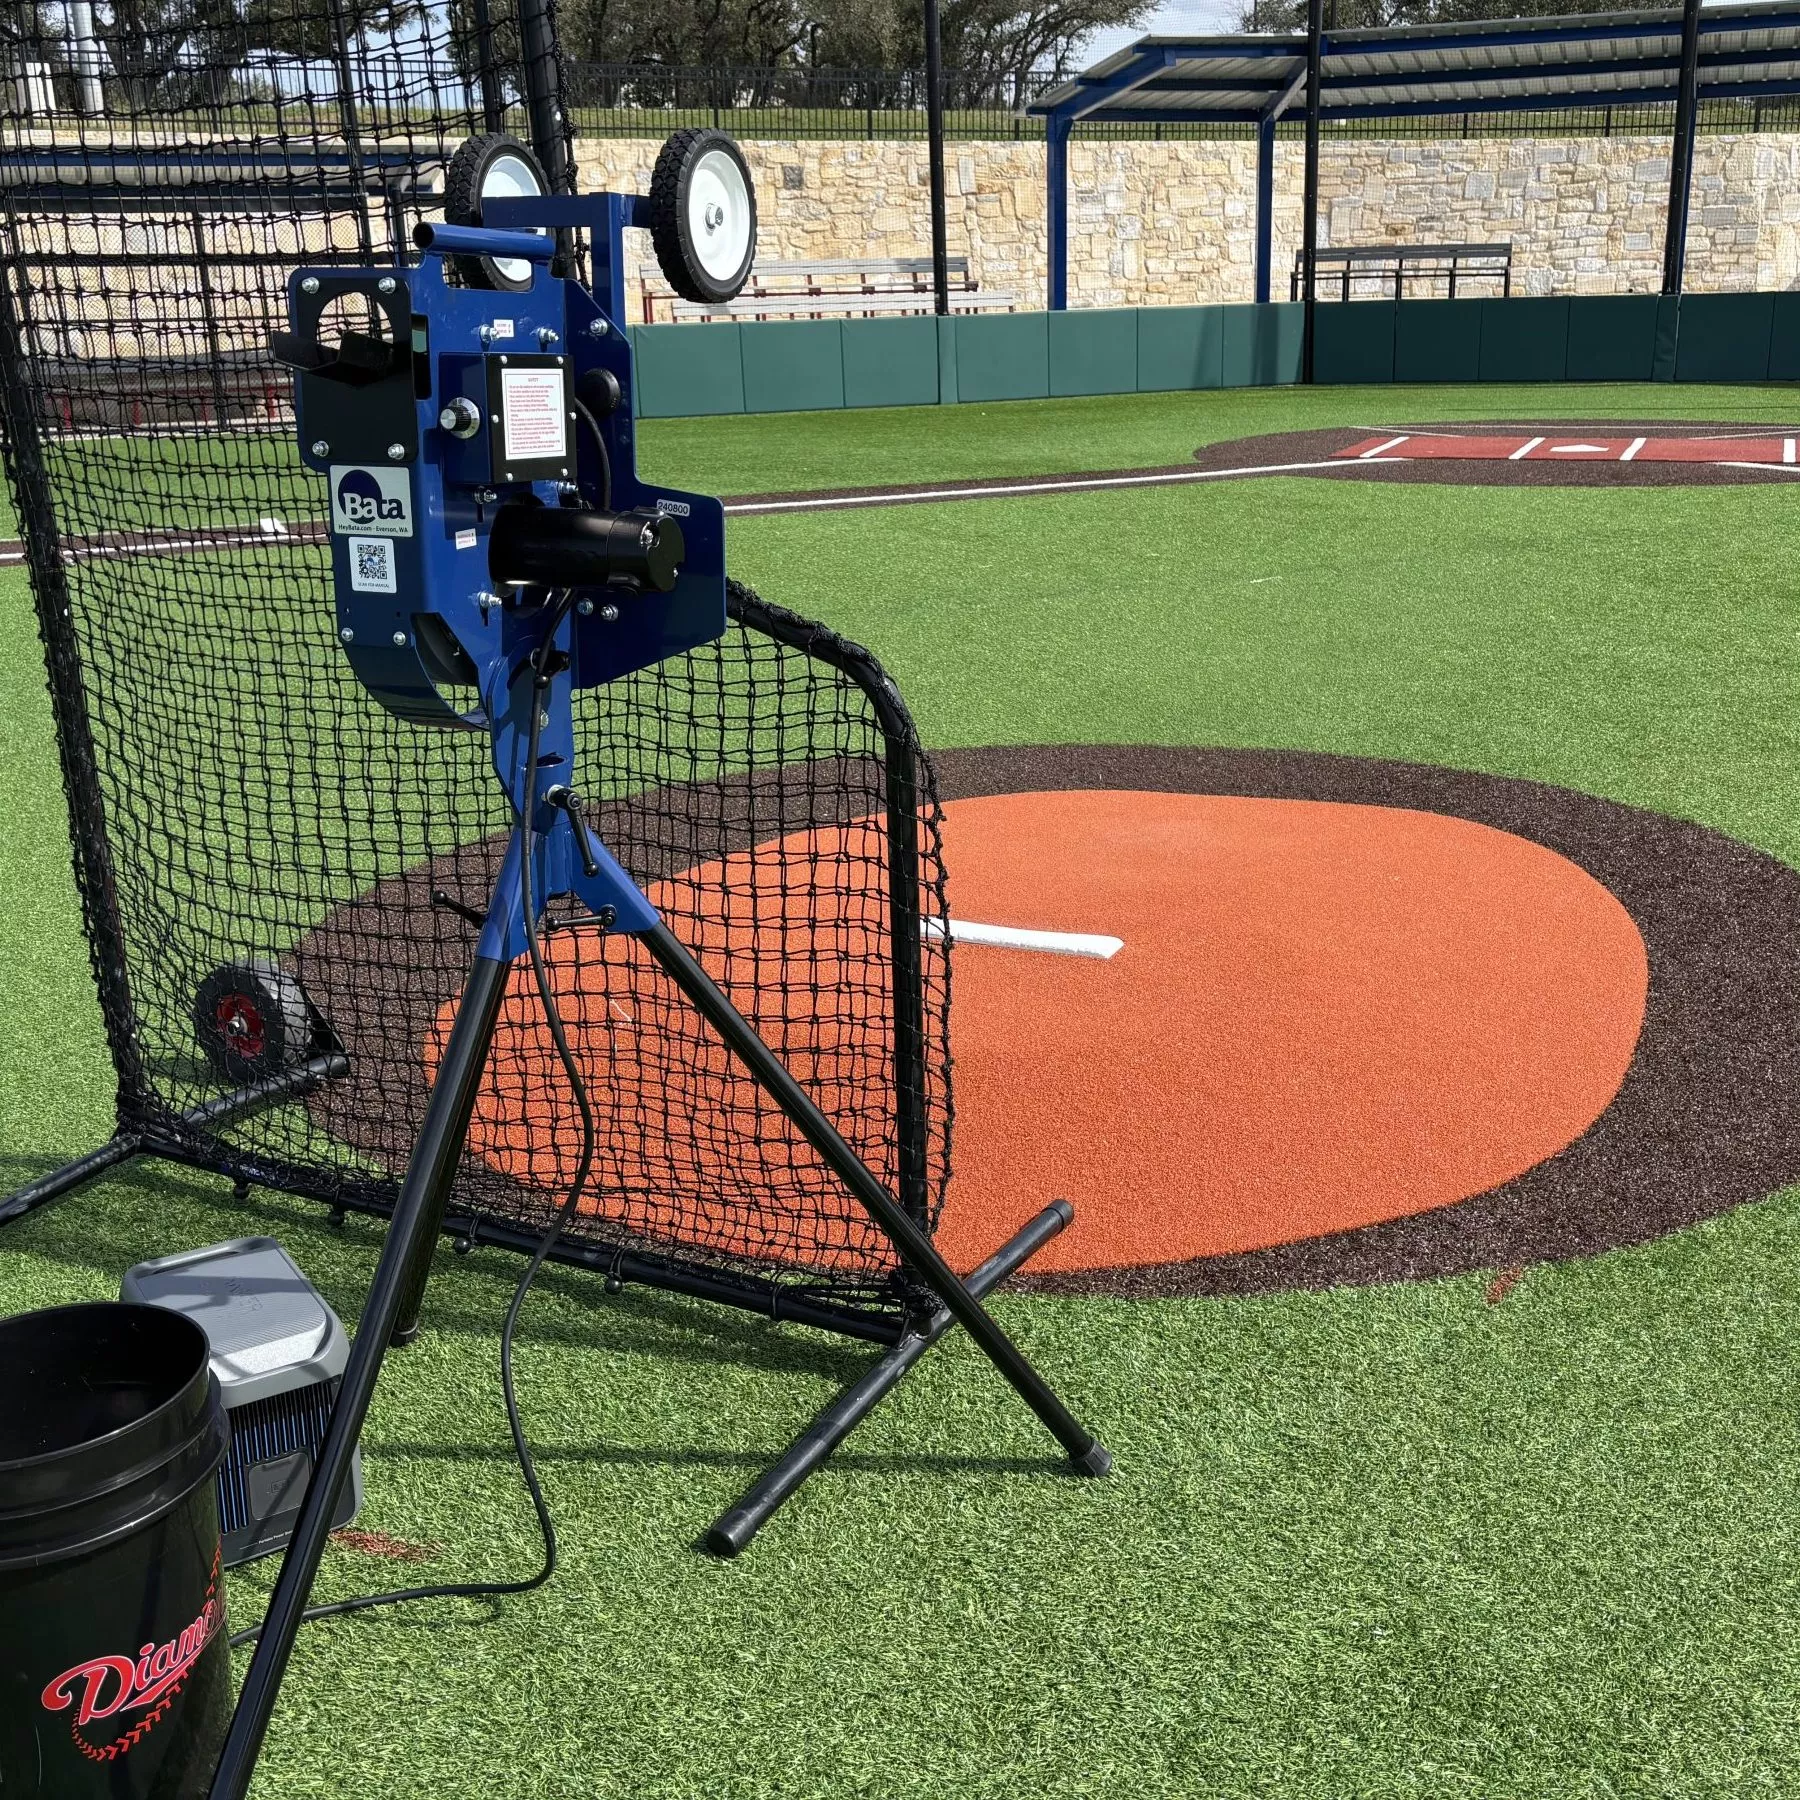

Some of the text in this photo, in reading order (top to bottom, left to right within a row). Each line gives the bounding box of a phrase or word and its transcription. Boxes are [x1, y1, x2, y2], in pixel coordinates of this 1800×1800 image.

[343, 492, 406, 520] Bata
[657, 501, 689, 515] 240800
[375, 525, 398, 533] Everson,
